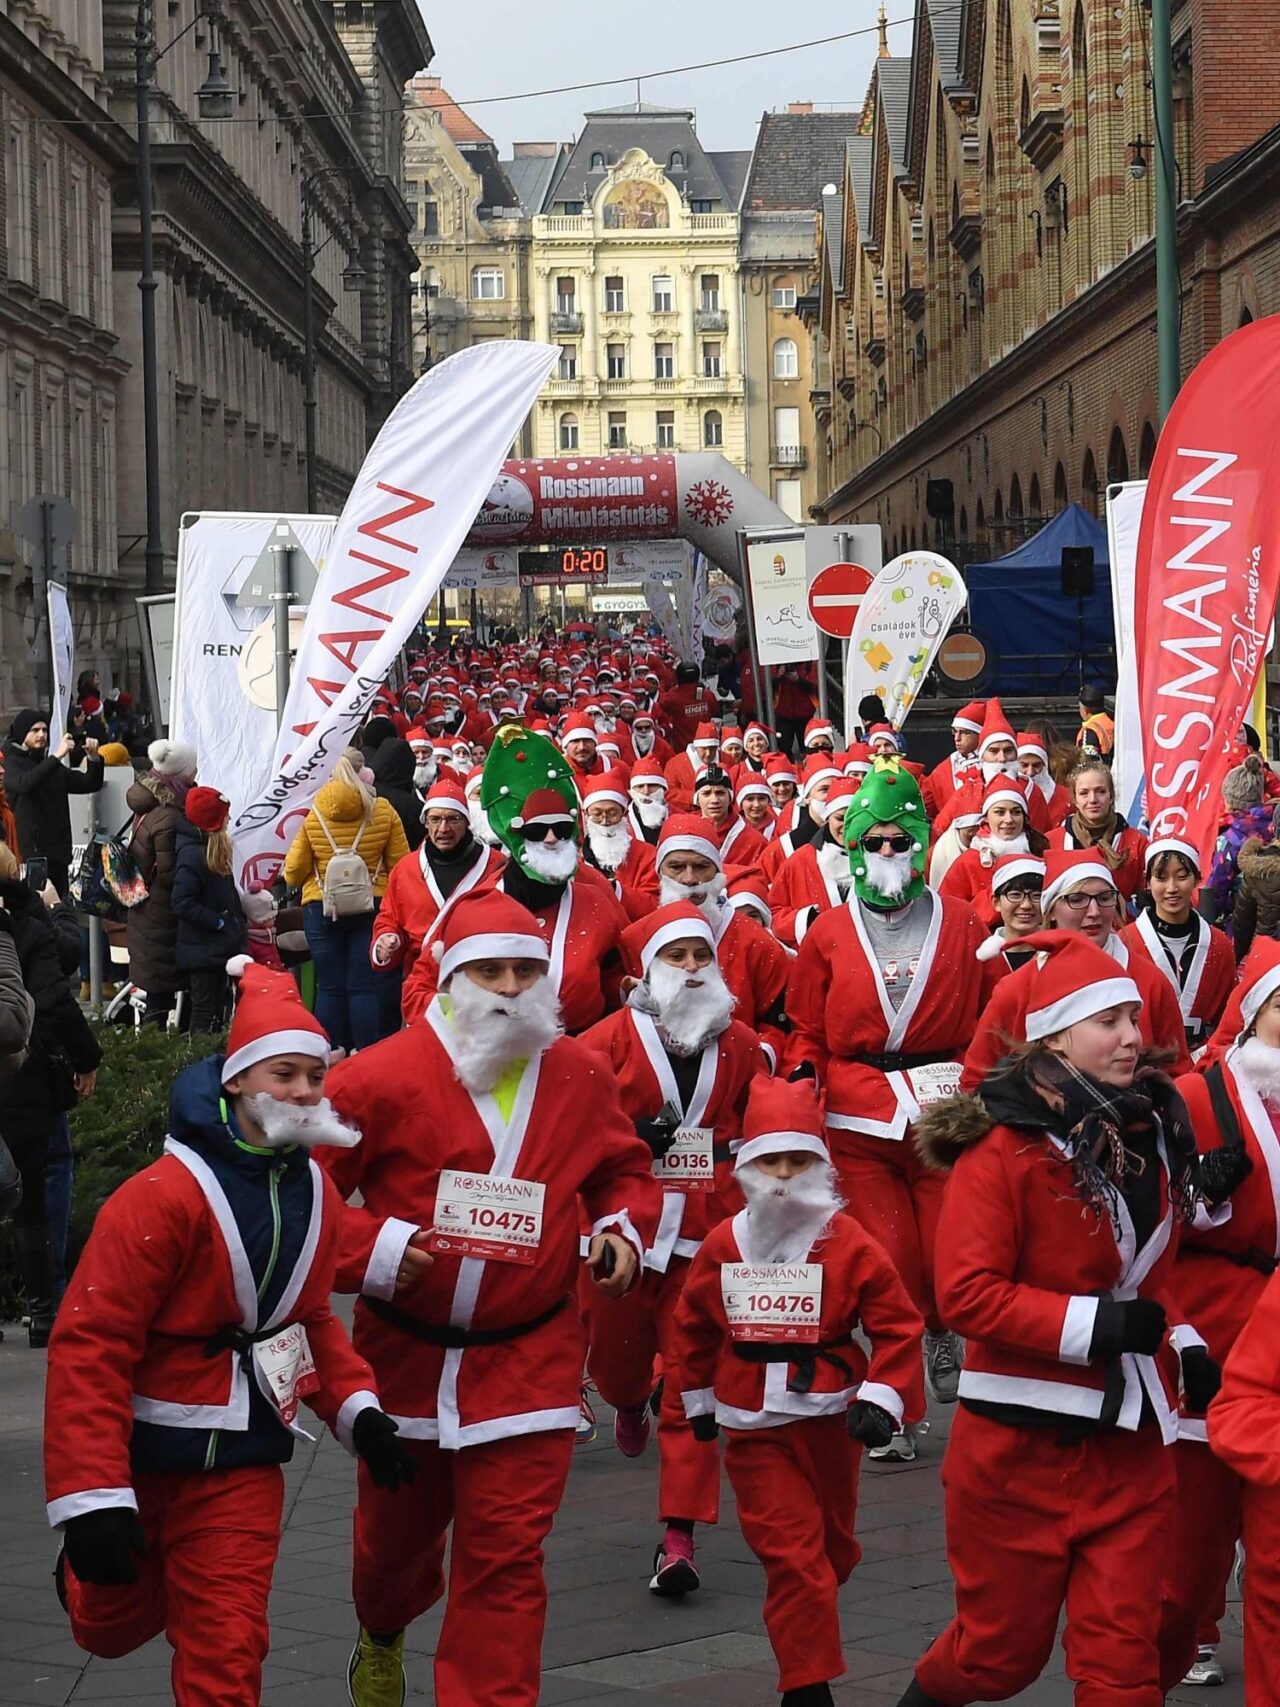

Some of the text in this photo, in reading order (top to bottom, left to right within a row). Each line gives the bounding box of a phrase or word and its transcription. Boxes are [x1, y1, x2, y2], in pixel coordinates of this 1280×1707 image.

[540, 475, 644, 499] Rossmann
[541, 503, 669, 529] Mikulásfutás
[563, 551, 605, 573] 0:20
[604, 600, 648, 610] GYÓGYS
[871, 622, 916, 632] Családok
[899, 630, 916, 639] éve
[203, 643, 243, 657] REN
[1150, 447, 1238, 841] OSSMANN
[677, 1132, 704, 1141] MANN
[662, 1154, 709, 1168] 10136
[454, 1176, 533, 1197] ROSSMANN
[469, 1207, 536, 1233] 10475
[733, 1268, 809, 1280] ROSSMANN
[748, 1295, 815, 1313] 10476
